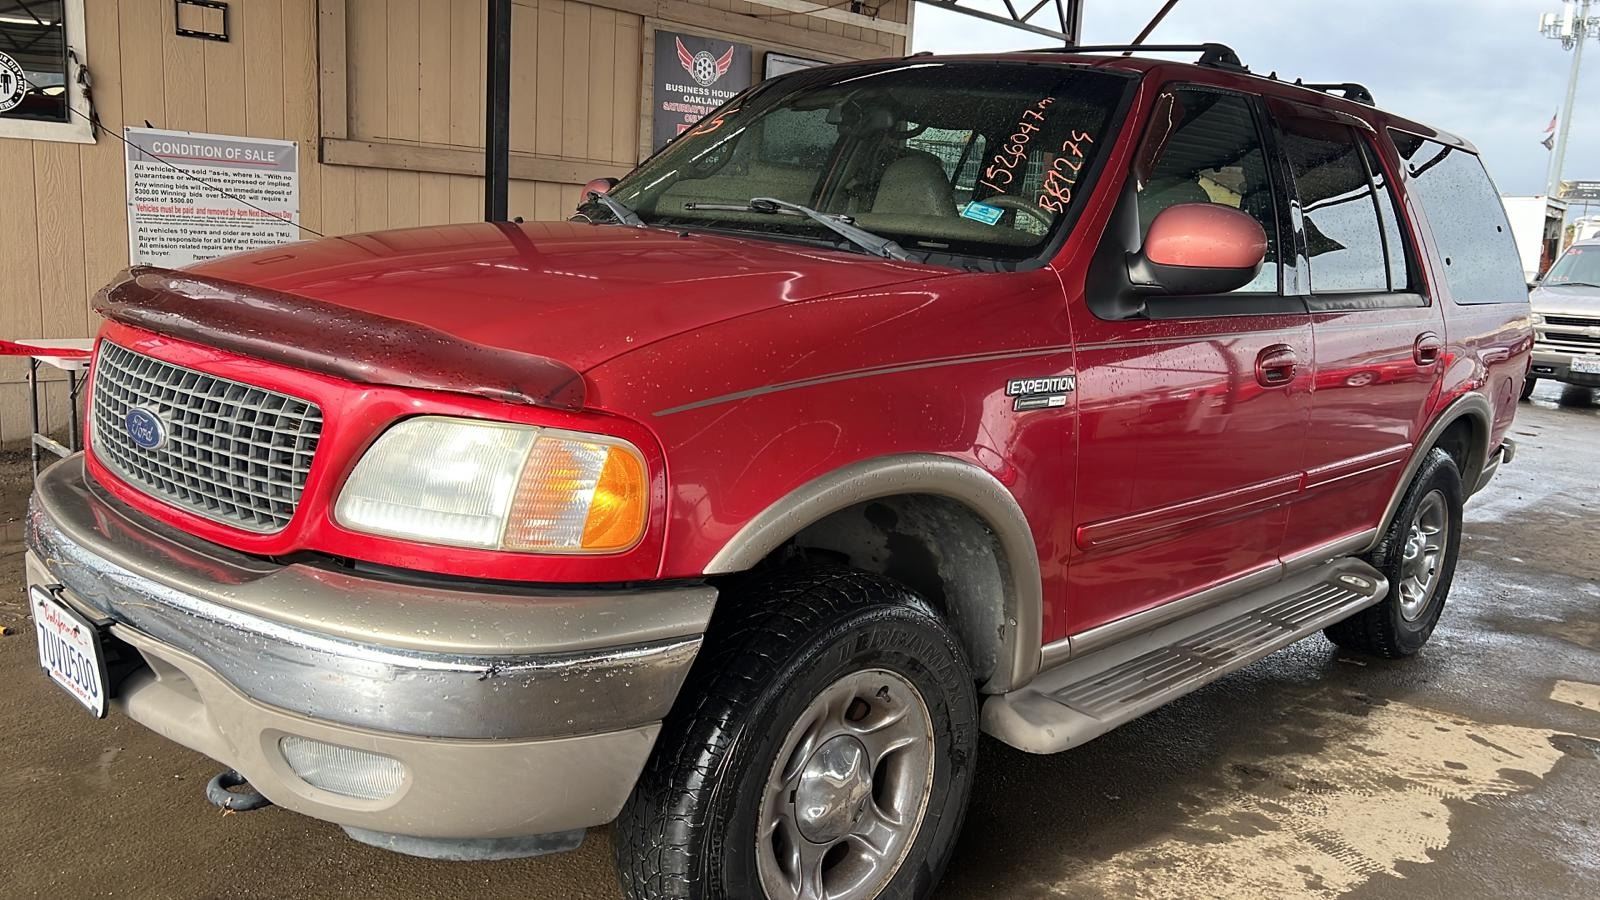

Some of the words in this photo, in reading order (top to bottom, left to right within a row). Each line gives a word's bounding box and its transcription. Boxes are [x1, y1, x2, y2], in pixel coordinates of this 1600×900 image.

[666, 83, 709, 95] BUSINESS
[683, 95, 724, 106] OAKLAND
[152, 141, 221, 158] CONDITION
[225, 148, 242, 159] OF
[245, 149, 275, 162] SALE
[146, 165, 176, 173] vehicles
[160, 190, 186, 198] Winning
[136, 203, 159, 212] Vehicles
[160, 205, 173, 213] must
[182, 206, 193, 214] paid
[207, 208, 227, 216] removed
[230, 209, 236, 218] by
[237, 210, 248, 218] 4pm
[283, 211, 292, 220] Day
[1010, 377, 1075, 394] EXPEDITION
[131, 415, 154, 442] Ford
[39, 622, 98, 698] 7UVD500
